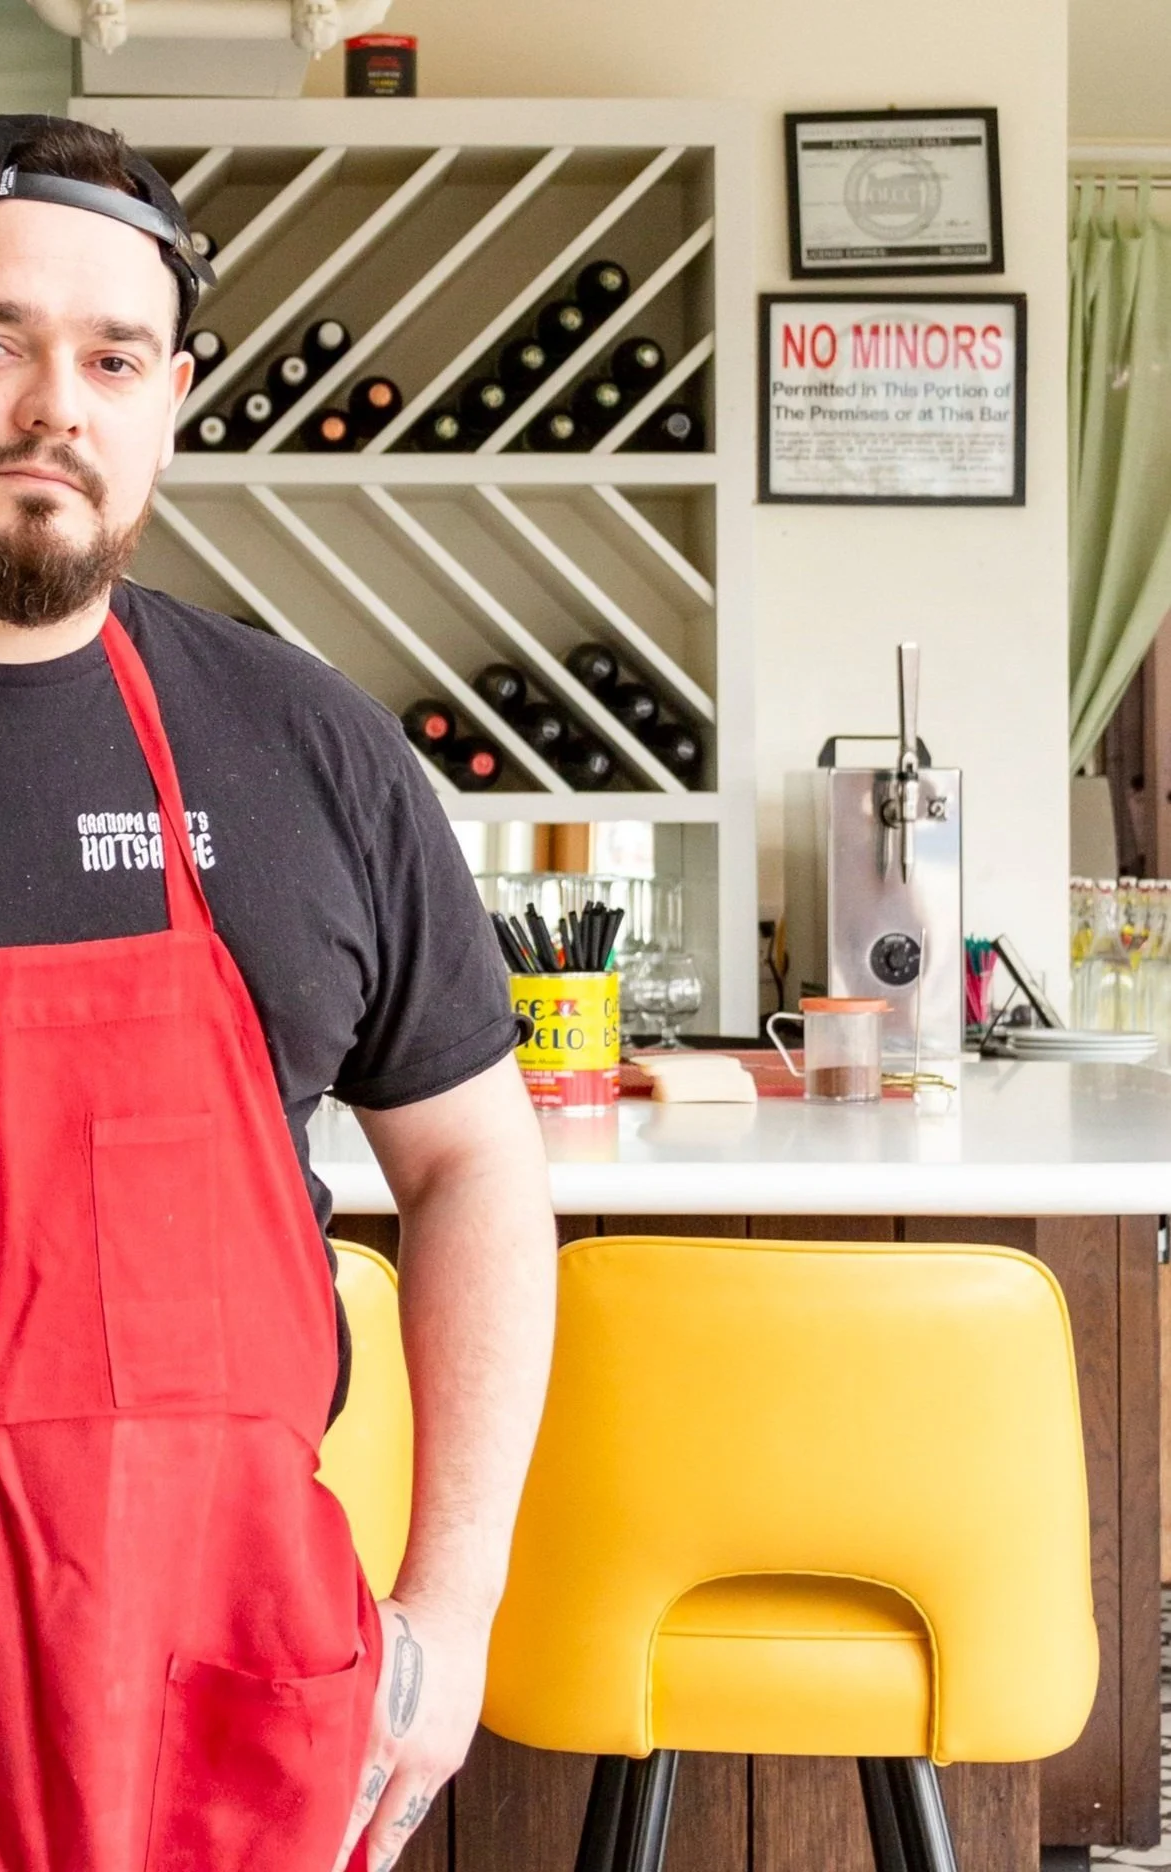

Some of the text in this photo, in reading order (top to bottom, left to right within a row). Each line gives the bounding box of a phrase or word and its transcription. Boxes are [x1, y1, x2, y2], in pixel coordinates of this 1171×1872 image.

[782, 323, 1003, 370] NO MINORS
[772, 381, 856, 398] Permitted
[883, 382, 918, 398] This
[924, 383, 988, 398] Portion
[994, 383, 1011, 398] of
[773, 406, 1009, 422] The Premises or at This Bar
[77, 812, 146, 834] GRANDPA
[79, 833, 216, 872] HOTSAE
[524, 1027, 585, 1050] ELO
